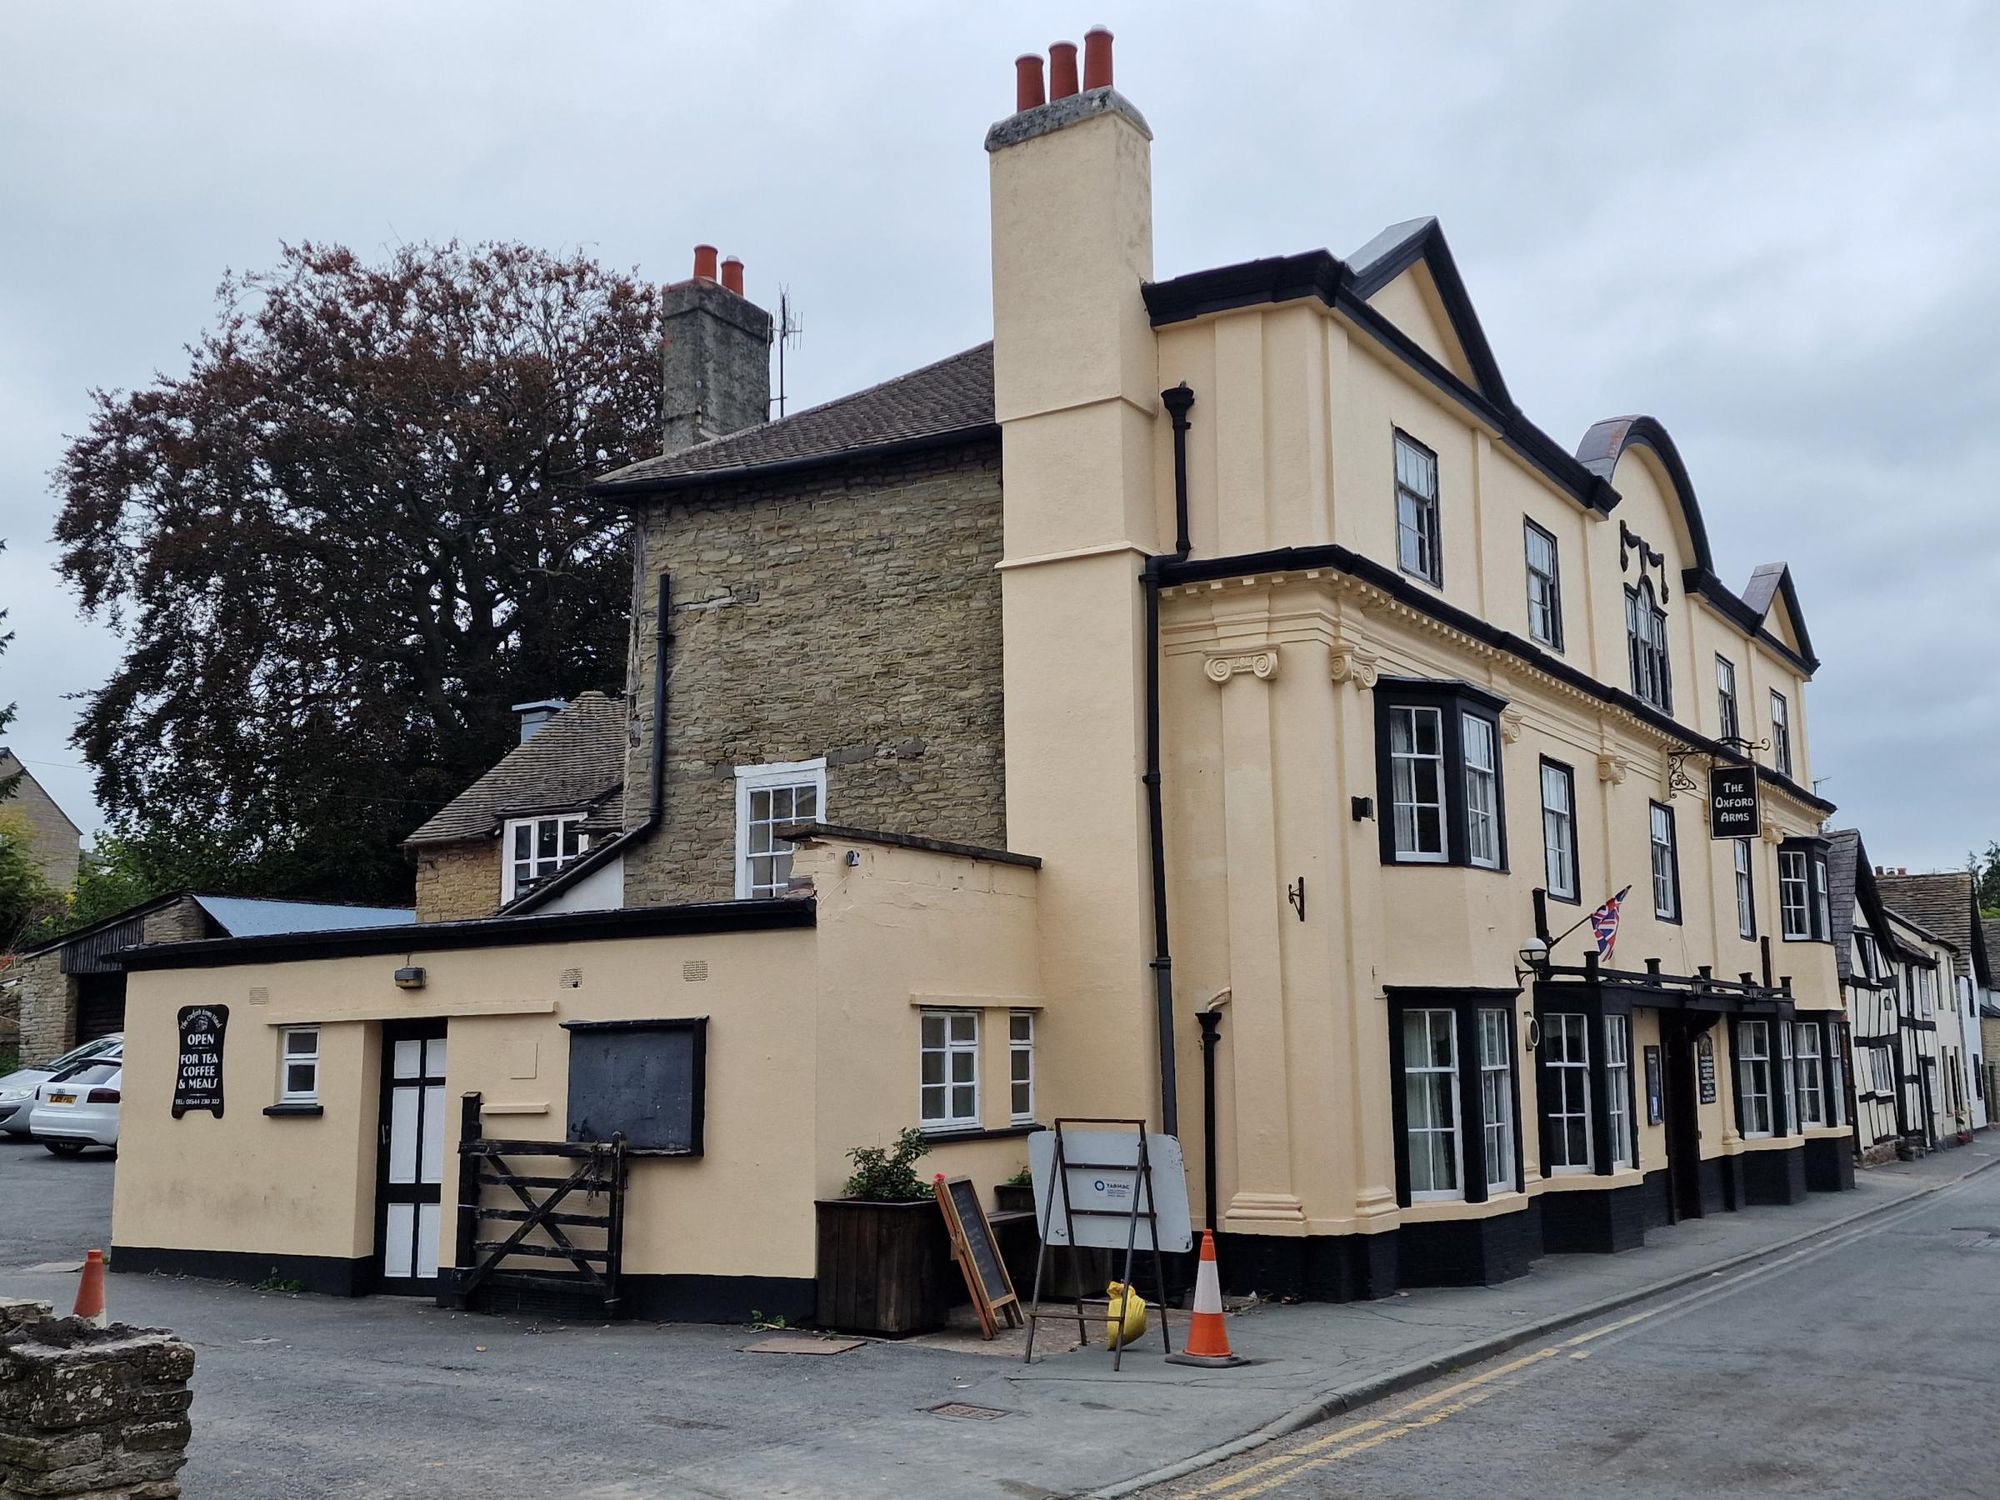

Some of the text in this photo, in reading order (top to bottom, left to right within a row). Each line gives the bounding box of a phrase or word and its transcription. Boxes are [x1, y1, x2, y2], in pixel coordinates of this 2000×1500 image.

[1722, 782, 1744, 793] THE
[1715, 796, 1754, 808] OXFORD
[1720, 811, 1750, 823] ARMS
[187, 1033, 215, 1046] OPEN
[180, 1053, 219, 1065] FOR TEA
[182, 1065, 216, 1077] COFFEE
[178, 1078, 219, 1089] & MEALS
